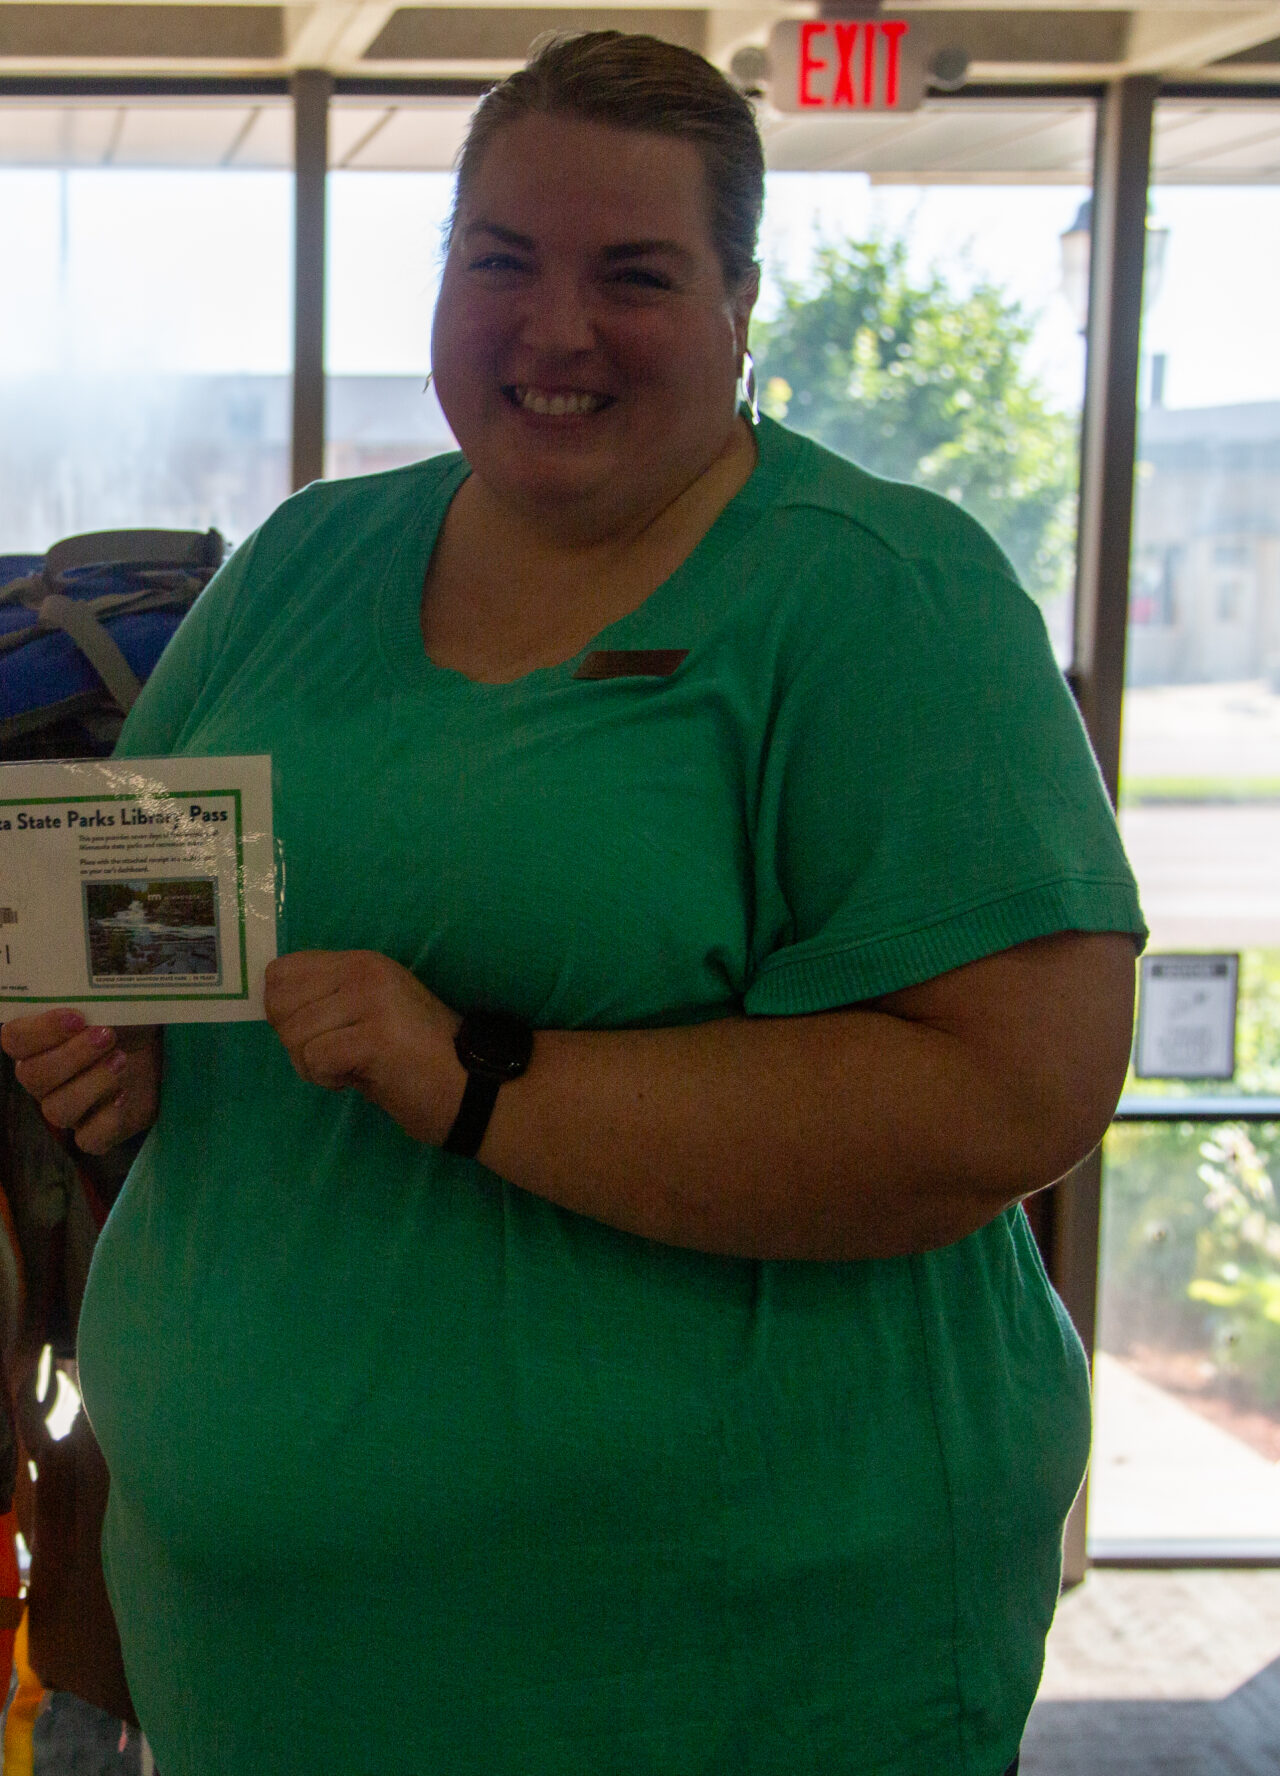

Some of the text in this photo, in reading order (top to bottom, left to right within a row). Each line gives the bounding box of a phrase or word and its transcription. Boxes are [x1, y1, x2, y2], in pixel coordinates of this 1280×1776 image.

[798, 20, 909, 109] EXIT
[17, 812, 61, 830] State
[67, 810, 115, 828] Parks
[189, 805, 228, 822] Pass
